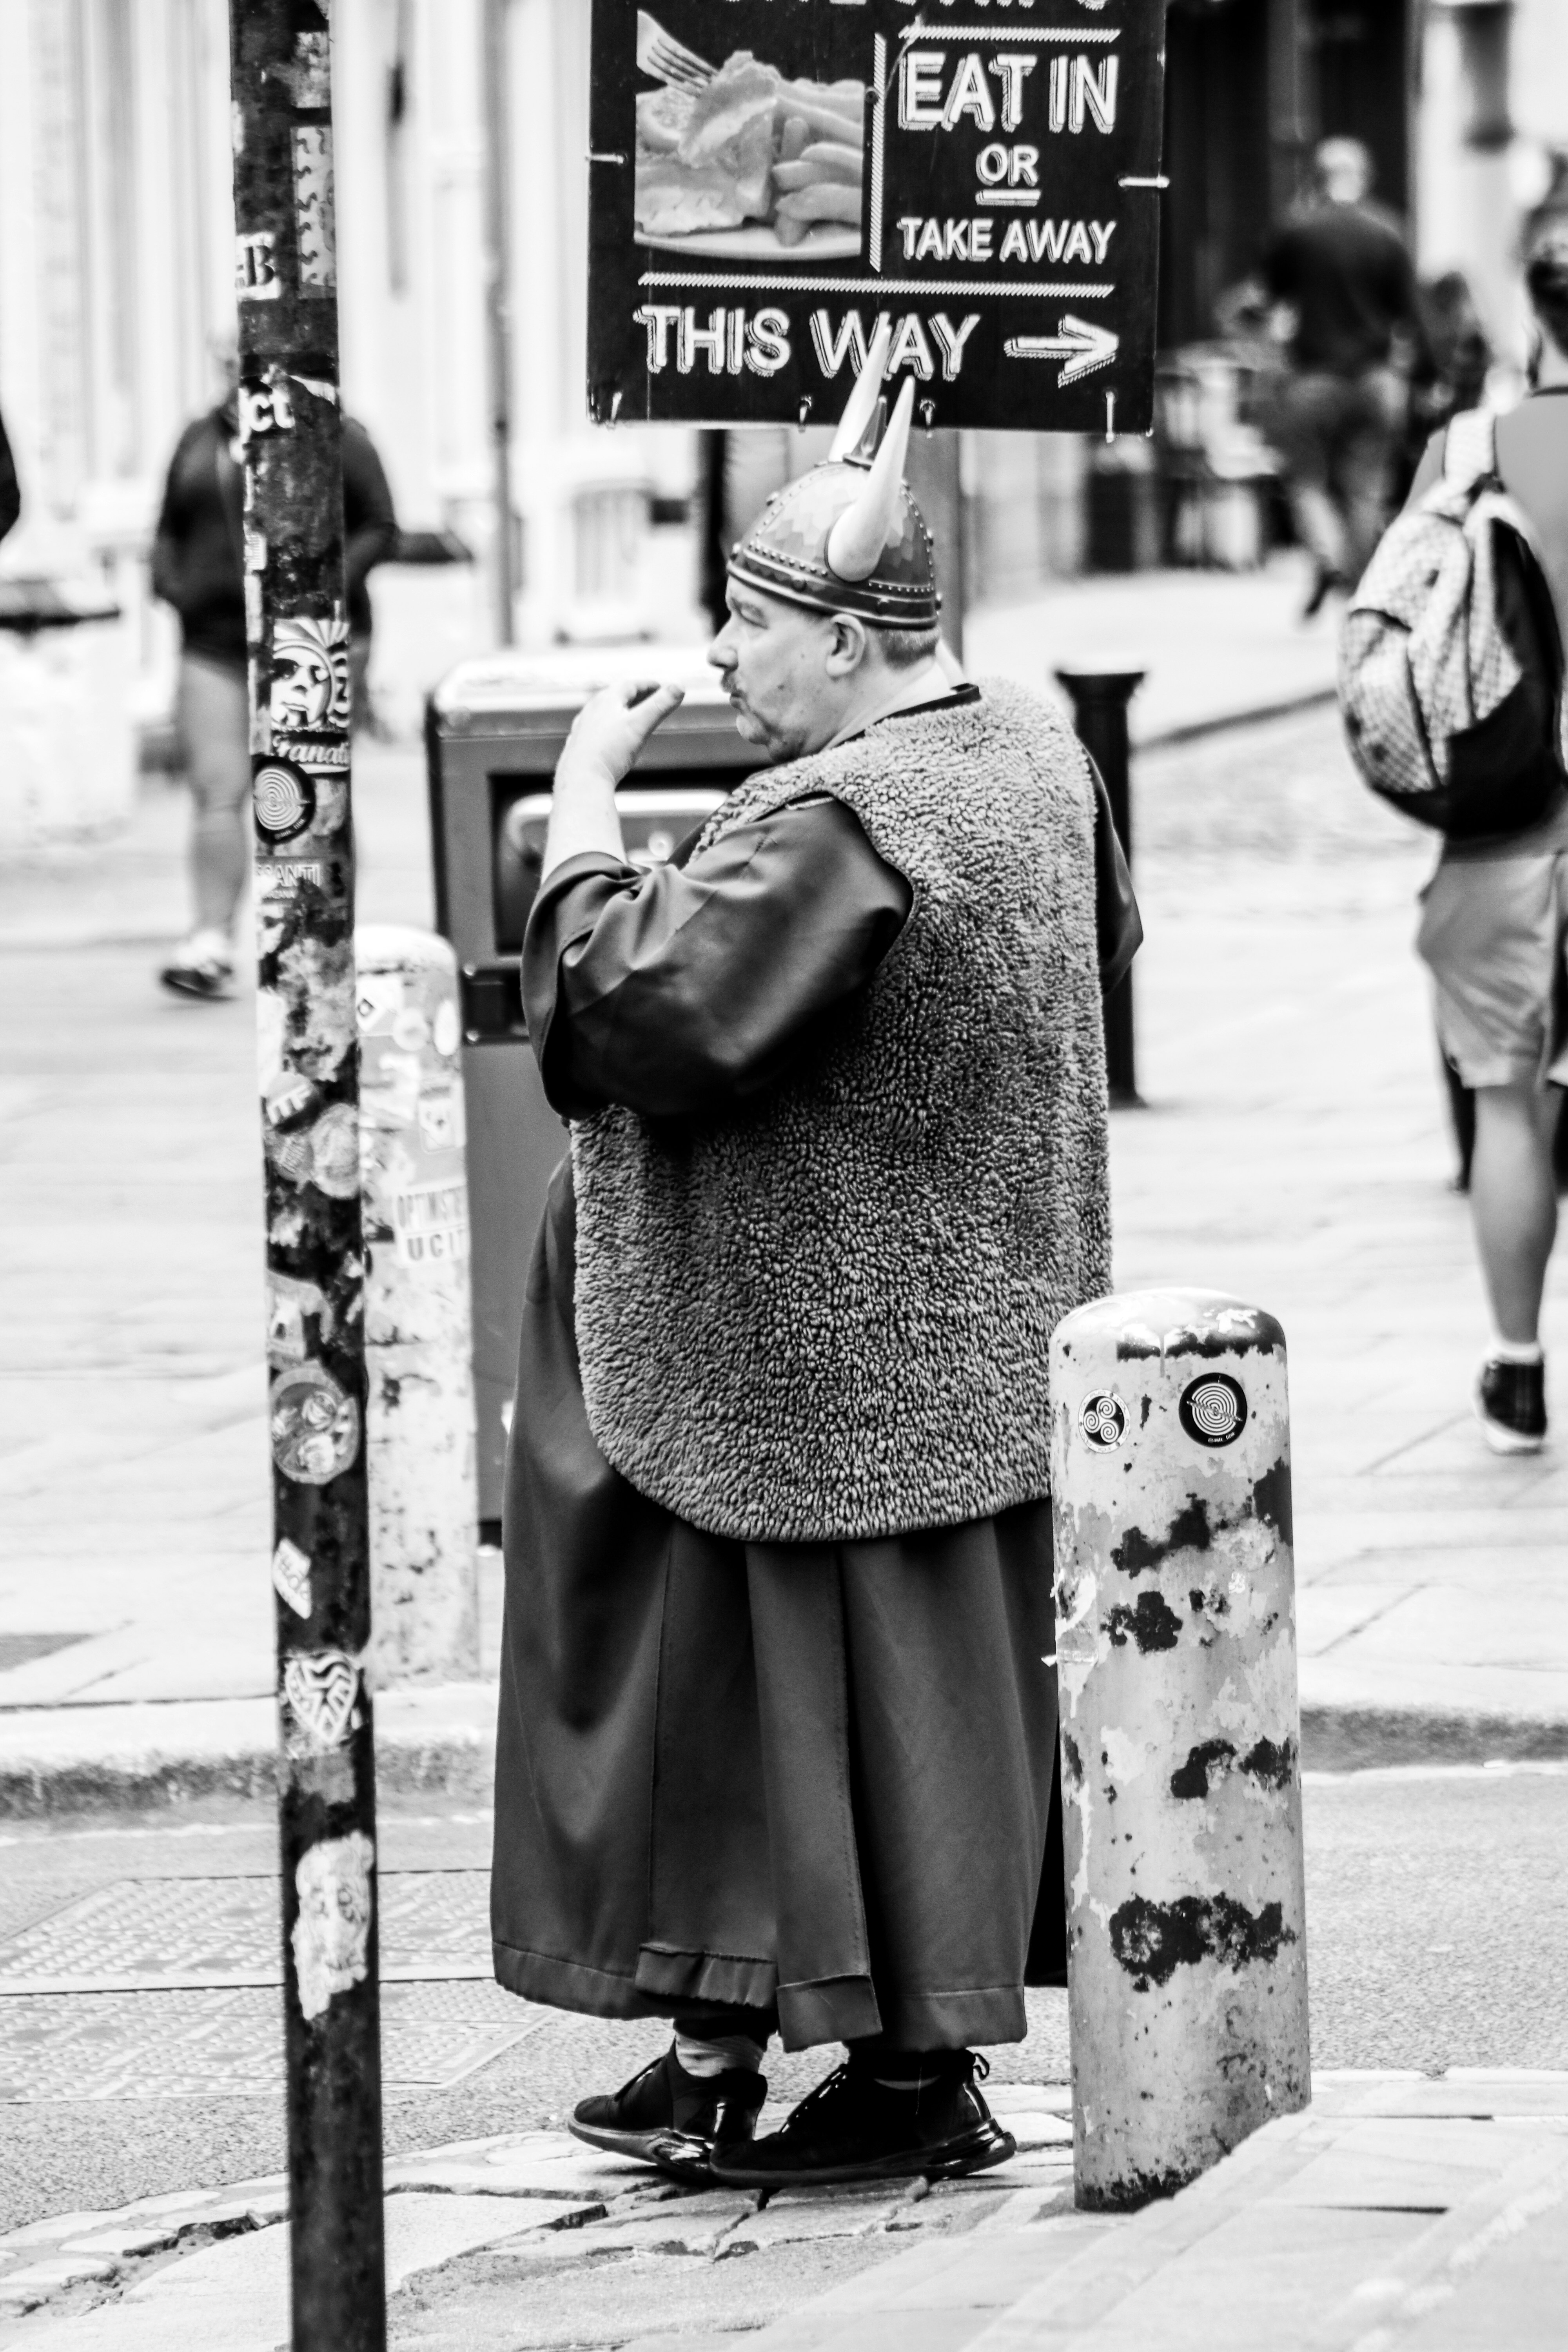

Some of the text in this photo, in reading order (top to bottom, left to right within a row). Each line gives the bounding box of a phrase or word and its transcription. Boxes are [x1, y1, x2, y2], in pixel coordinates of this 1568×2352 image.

[898, 52, 1118, 134] EAT IN
[975, 143, 1039, 187] OR
[897, 217, 1117, 264] TAKE AWAY
[633, 305, 981, 382] THIS WAY
